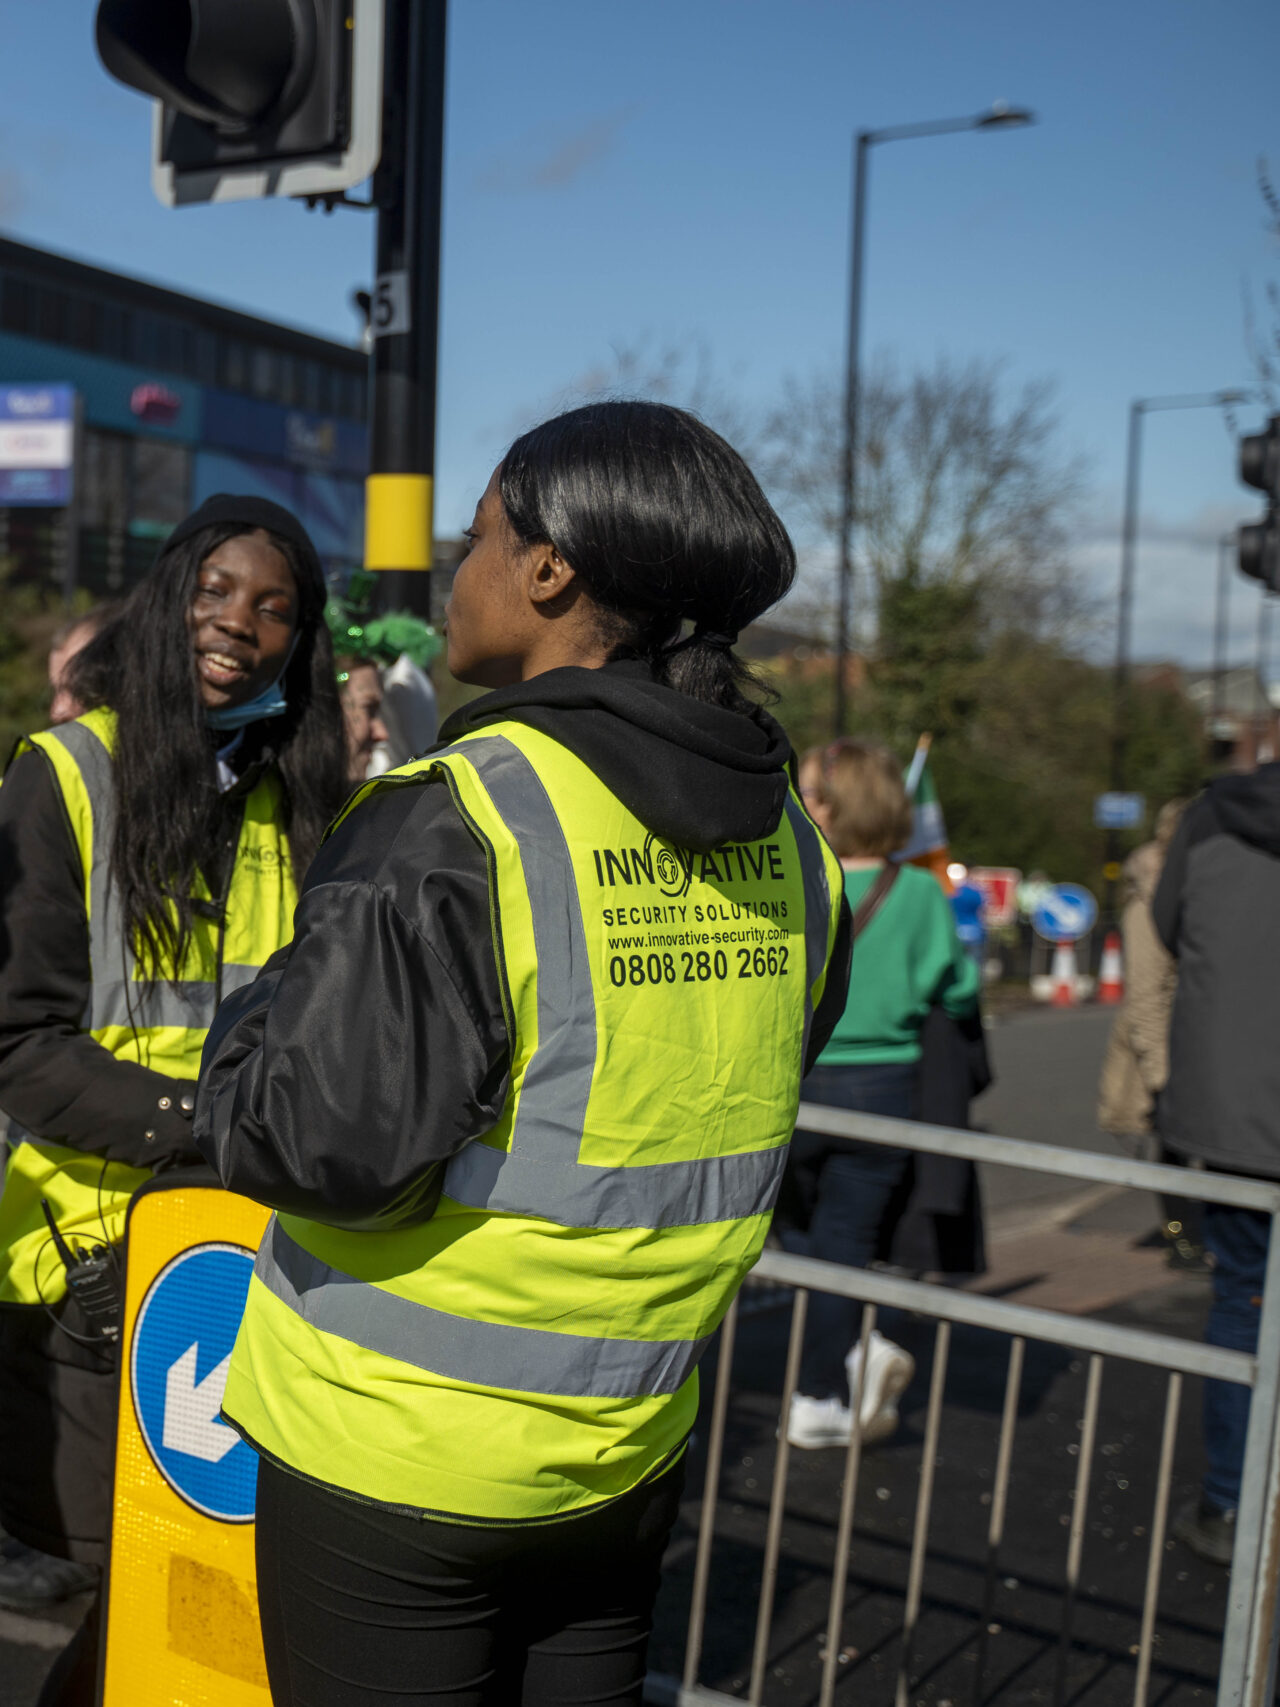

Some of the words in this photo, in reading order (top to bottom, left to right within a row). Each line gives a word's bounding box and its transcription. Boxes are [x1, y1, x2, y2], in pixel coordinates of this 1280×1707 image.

[593, 836, 786, 895] INNOVATIVE
[602, 905, 688, 927] SECURITY
[695, 900, 789, 923] SOLUTIONS
[608, 927, 789, 951] www.innovative-security.com
[609, 952, 677, 988] 0808
[681, 949, 728, 983] 280
[736, 945, 790, 979] 2662
